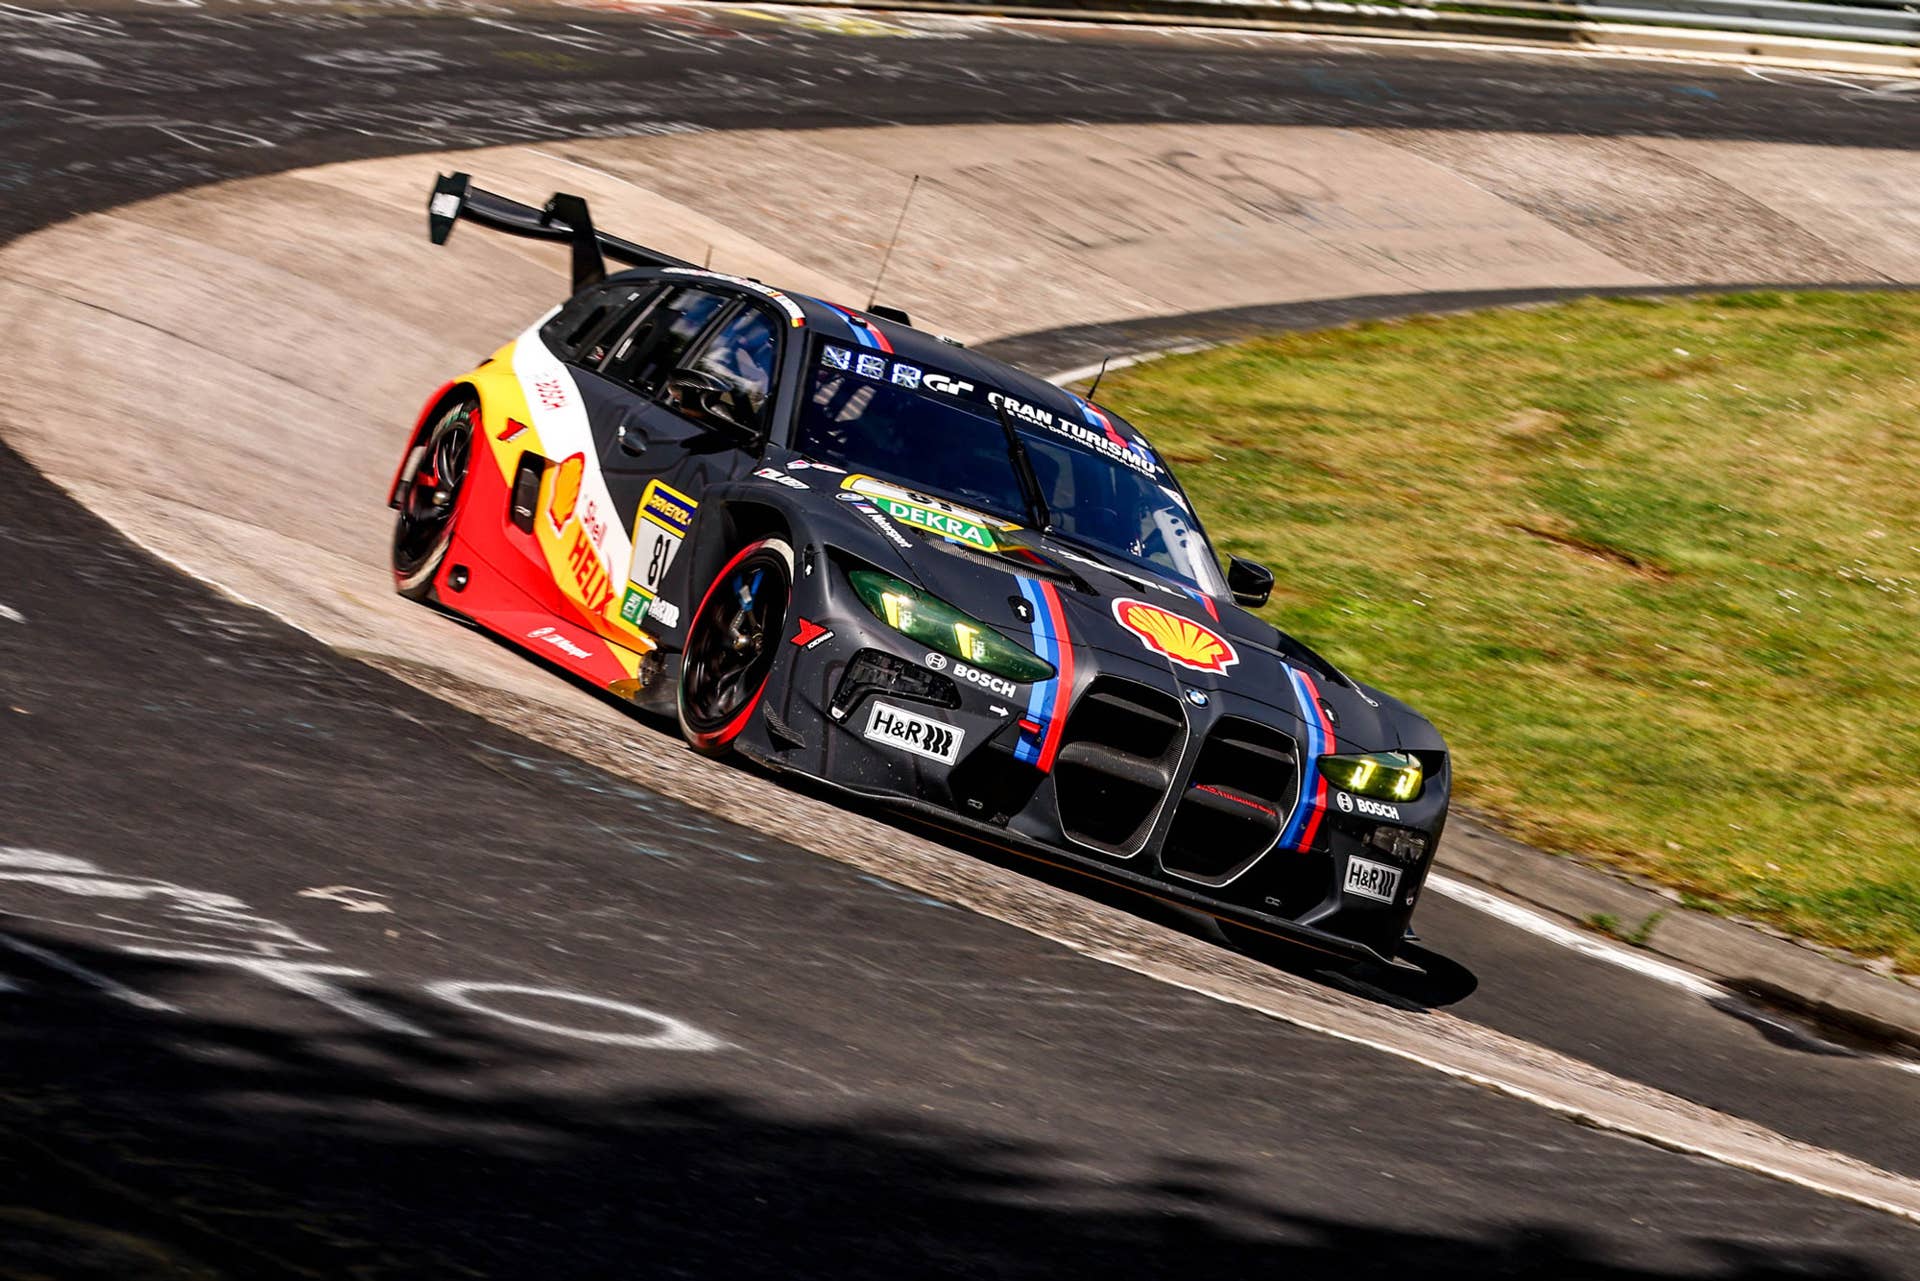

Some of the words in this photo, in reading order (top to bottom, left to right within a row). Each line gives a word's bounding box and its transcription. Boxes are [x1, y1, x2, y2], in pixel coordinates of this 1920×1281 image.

[1058, 418, 1156, 474] TURISMO
[889, 502, 984, 545] DEKRA
[568, 529, 615, 616] HELIX
[647, 533, 671, 588] 81
[953, 663, 1016, 698] BOSCH
[872, 710, 922, 745] H&R
[1356, 798, 1400, 820] BOSCH
[1349, 861, 1380, 890] H&R
